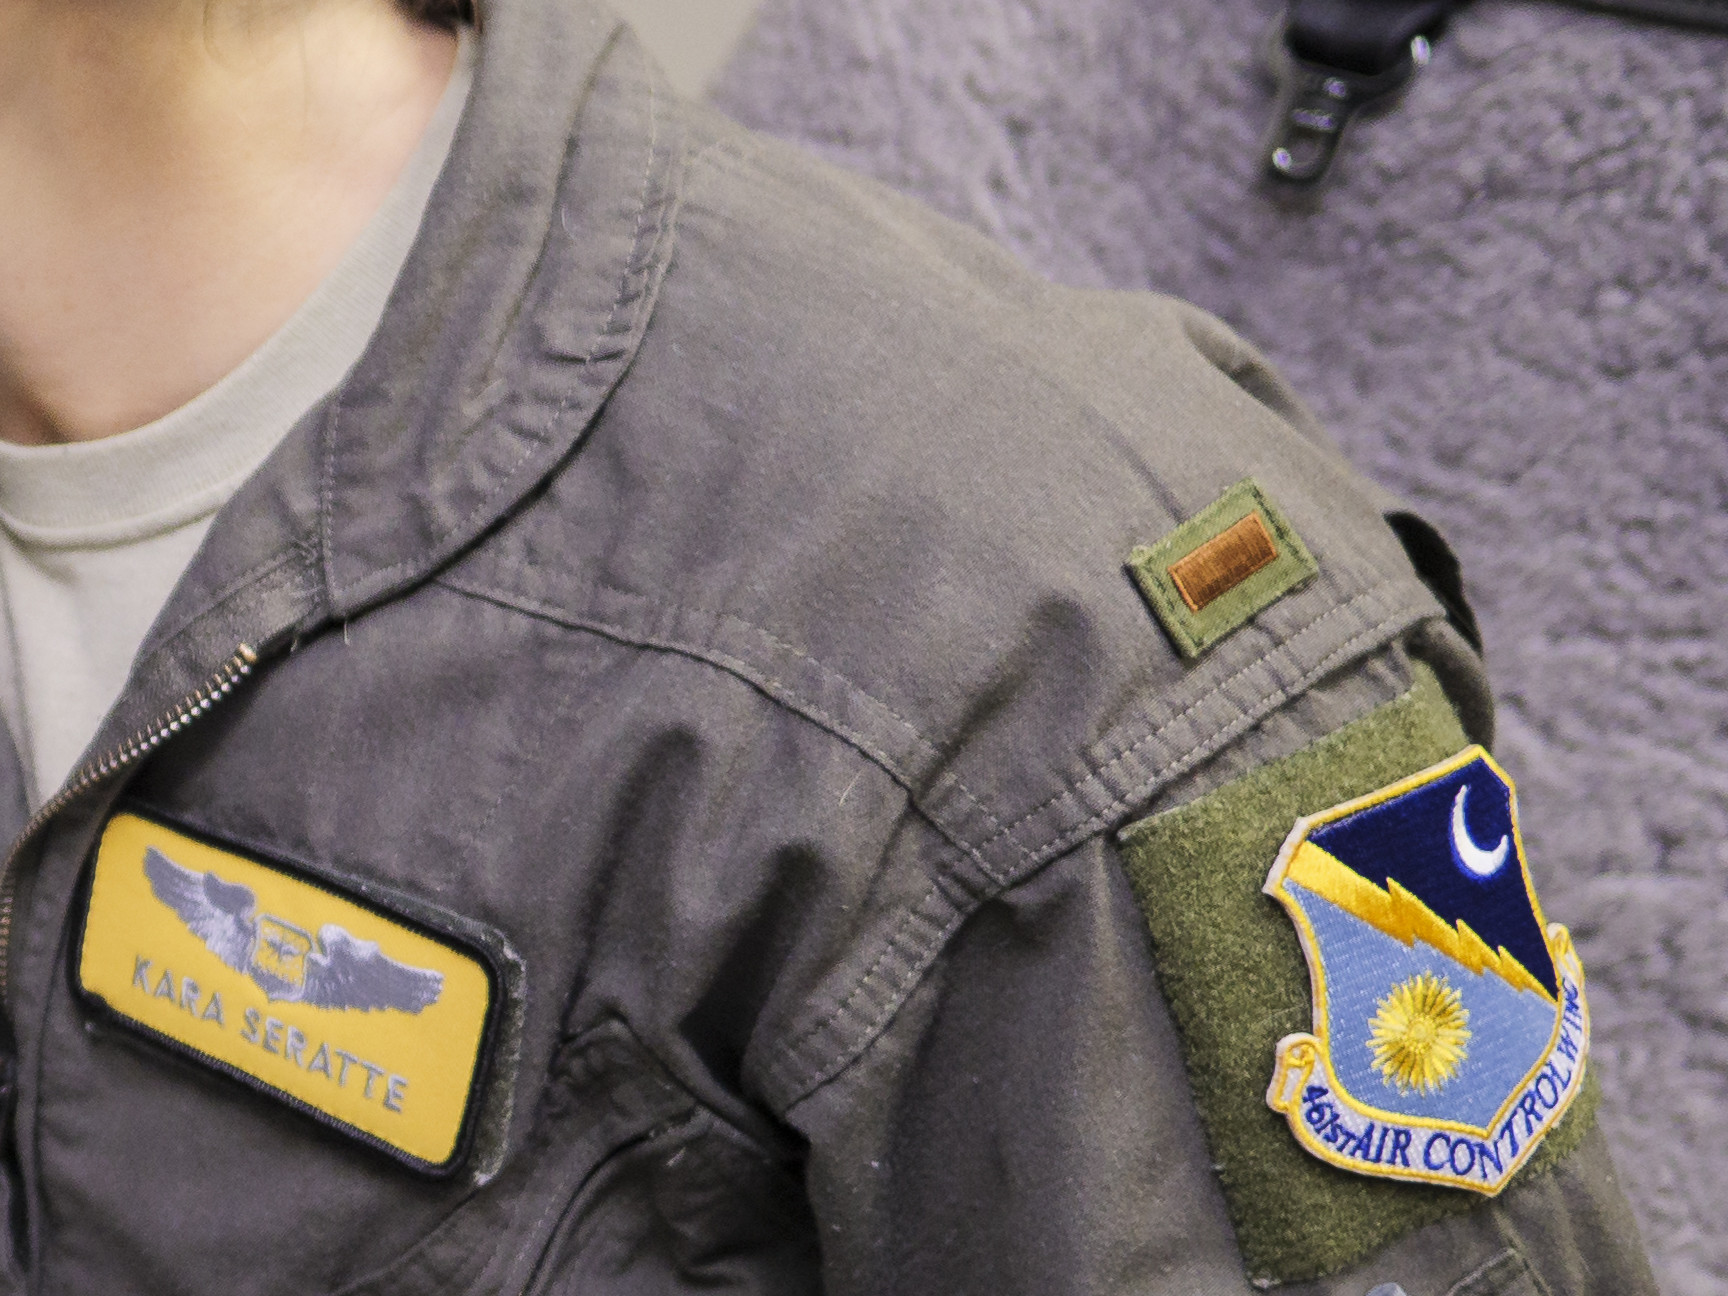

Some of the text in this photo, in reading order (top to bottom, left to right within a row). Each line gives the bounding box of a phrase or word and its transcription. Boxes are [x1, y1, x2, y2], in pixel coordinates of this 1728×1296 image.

[132, 954, 410, 1116] KARA SERATTE
[1353, 1122, 1413, 1168] AIR
[1423, 1060, 1573, 1181] CONTROL
